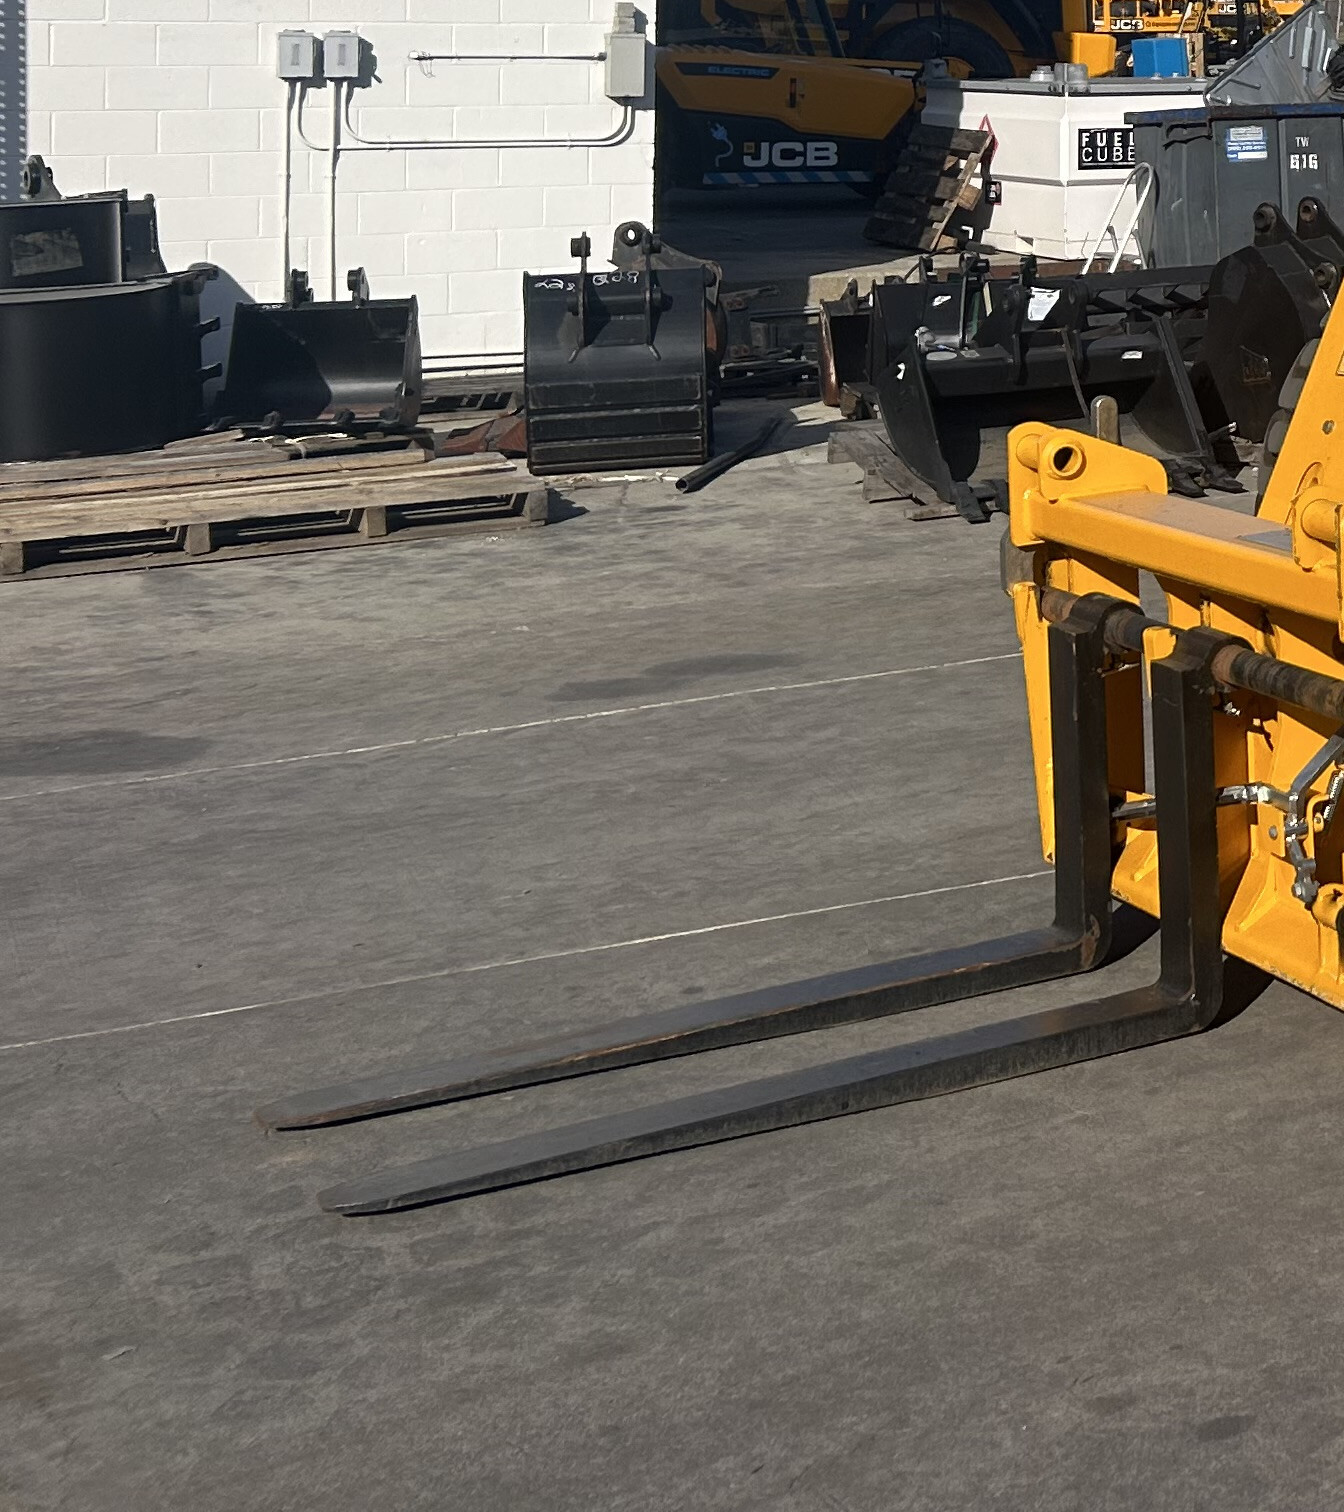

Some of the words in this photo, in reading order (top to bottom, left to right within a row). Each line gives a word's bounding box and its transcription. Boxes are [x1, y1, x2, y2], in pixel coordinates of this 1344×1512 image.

[1219, 4, 1237, 13] JC
[707, 65, 770, 77] ELECTRIC
[1082, 132, 1134, 147] FUEL
[743, 142, 838, 168] JCB
[1082, 147, 1135, 162] CUBE
